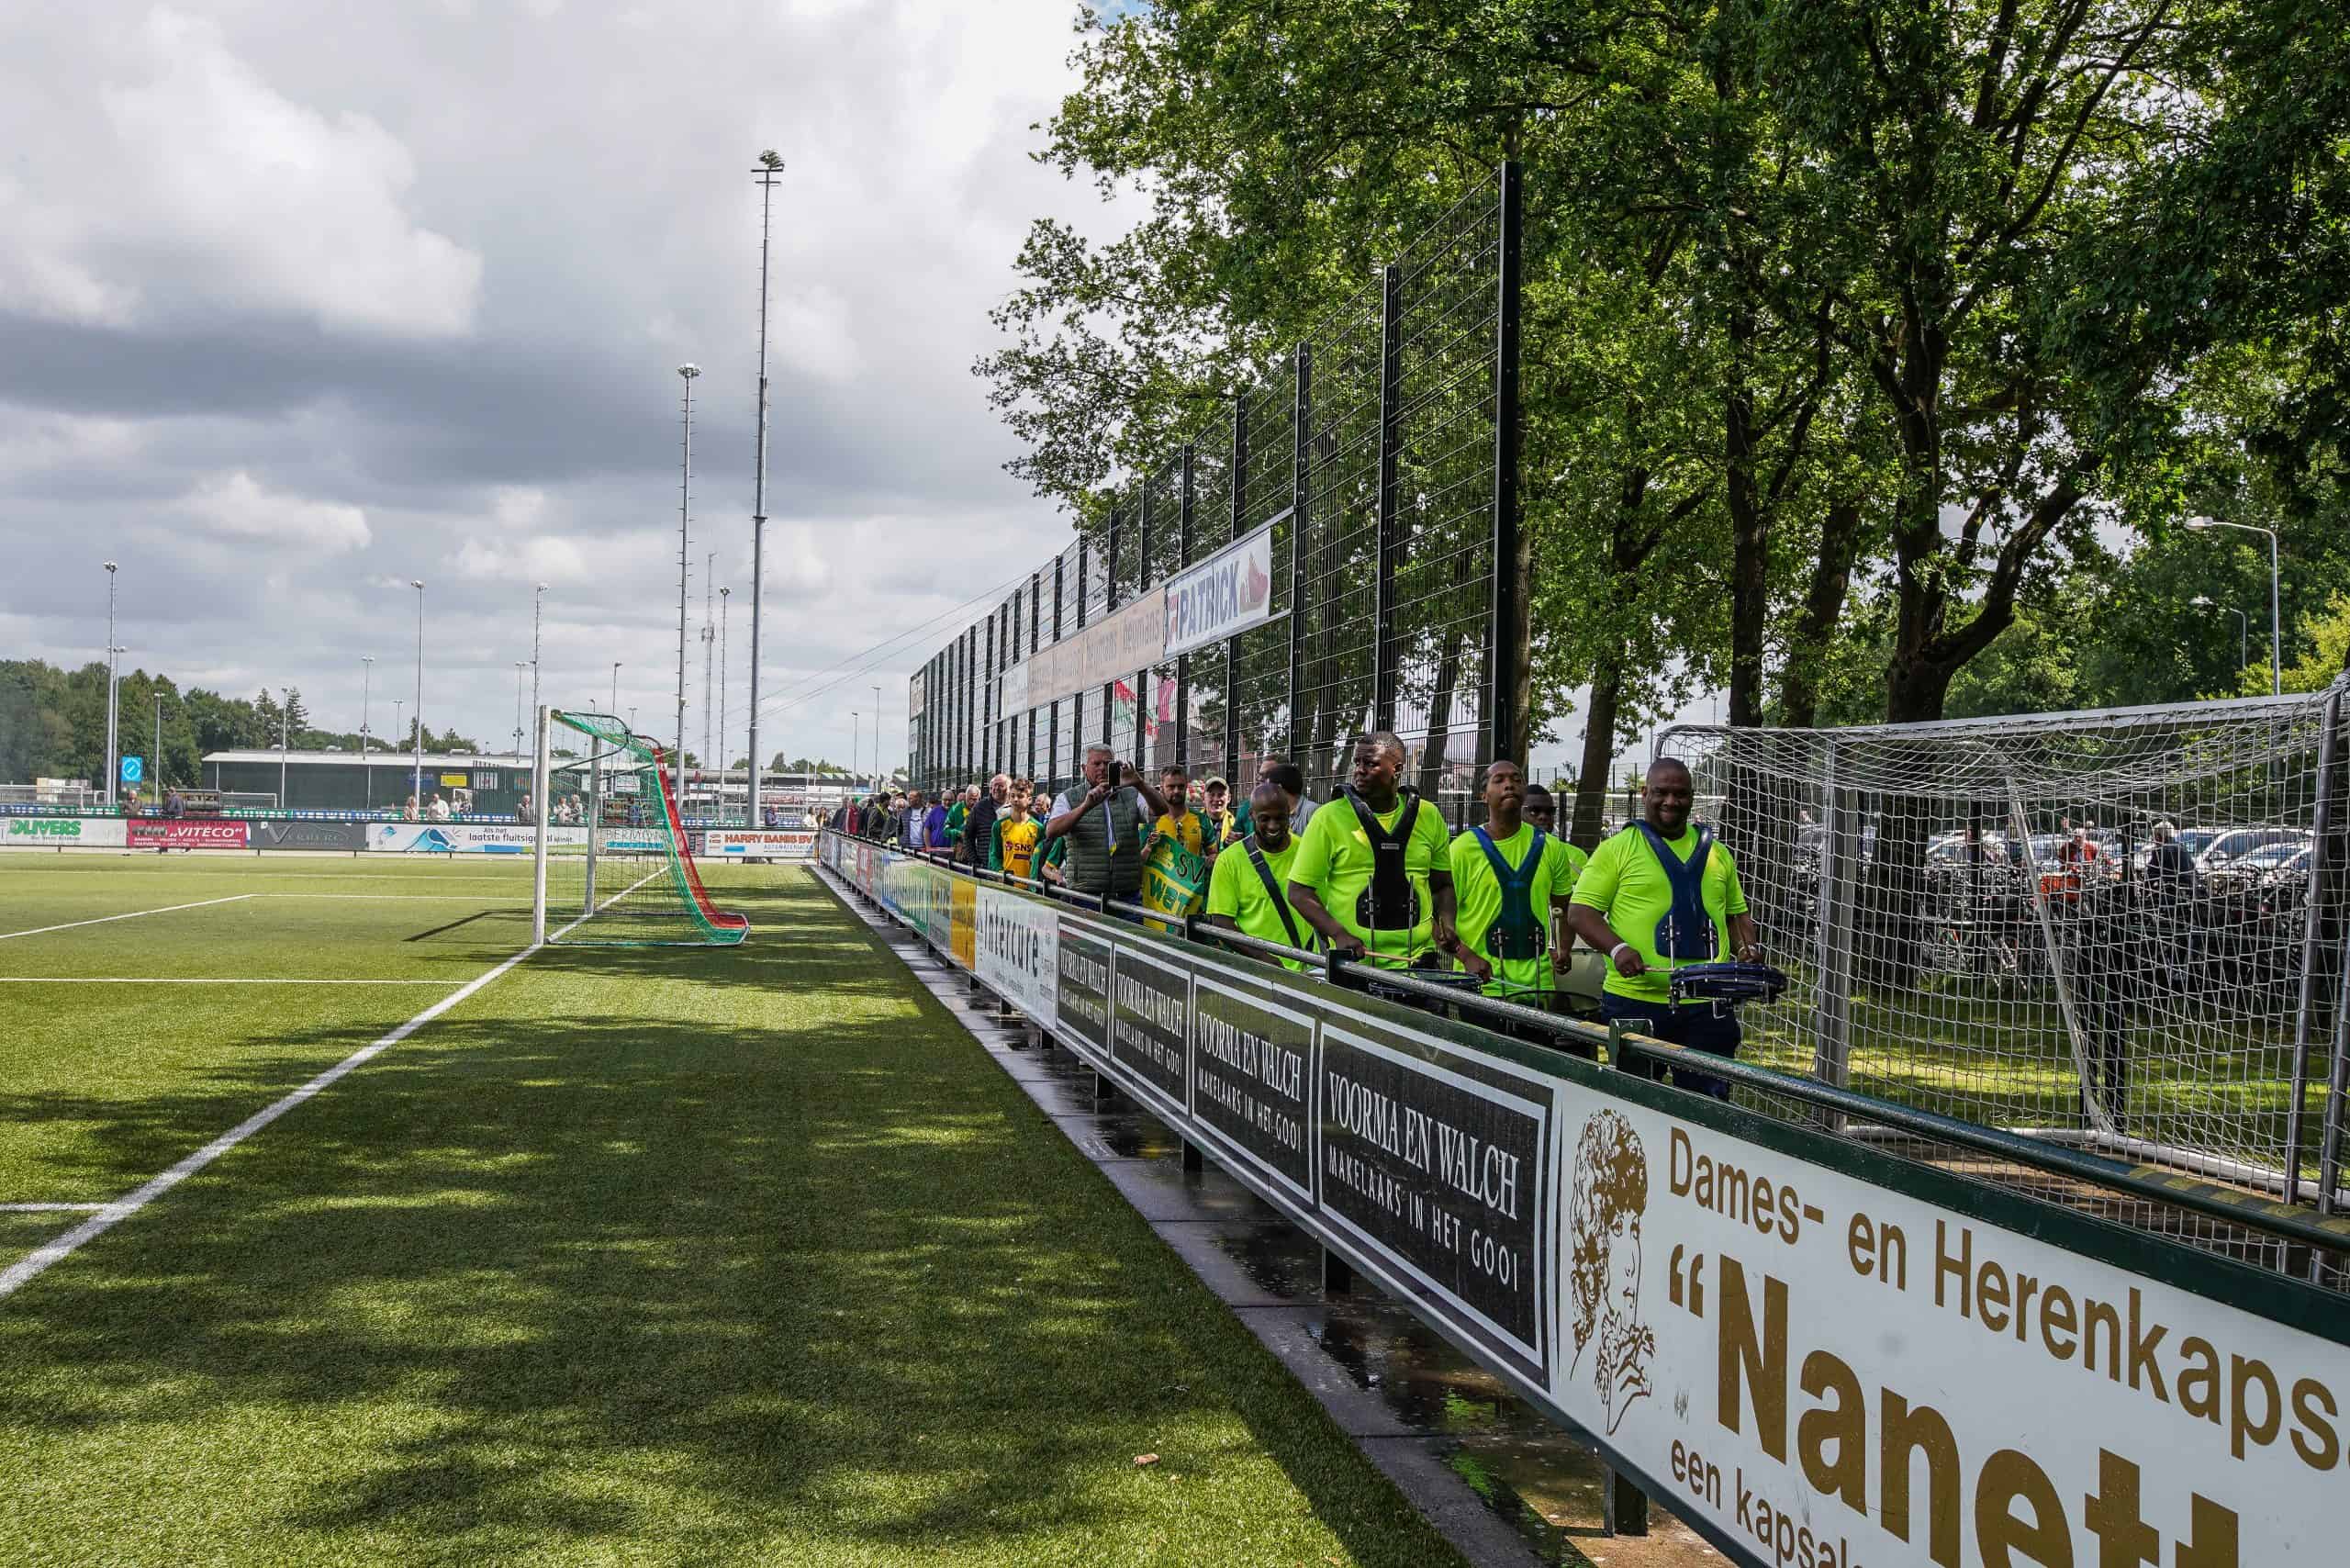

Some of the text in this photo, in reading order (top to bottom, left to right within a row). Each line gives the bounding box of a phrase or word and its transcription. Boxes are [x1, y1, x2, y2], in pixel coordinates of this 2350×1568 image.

[1179, 560, 1240, 641] PATRICK
[469, 833, 500, 842] laatste
[1014, 844, 1032, 852] SNS
[984, 899, 1039, 978] Intercure
[1117, 972, 1183, 1038] VOORMA EN WALCH
[1115, 1018, 1182, 1078] MAKELAARS IN HET GOOI
[1199, 1012, 1302, 1102] VOORMA EN WALCH
[1199, 1065, 1301, 1154] MAKELAARS IN HET GOOI
[1329, 1071, 1521, 1221] VOORMA EN WALCH
[1329, 1144, 1517, 1294] MAKELAARS IN HET GOOI
[1669, 1126, 2350, 1472] Dames- en Herenkaps
[1671, 1439, 1722, 1511] een
